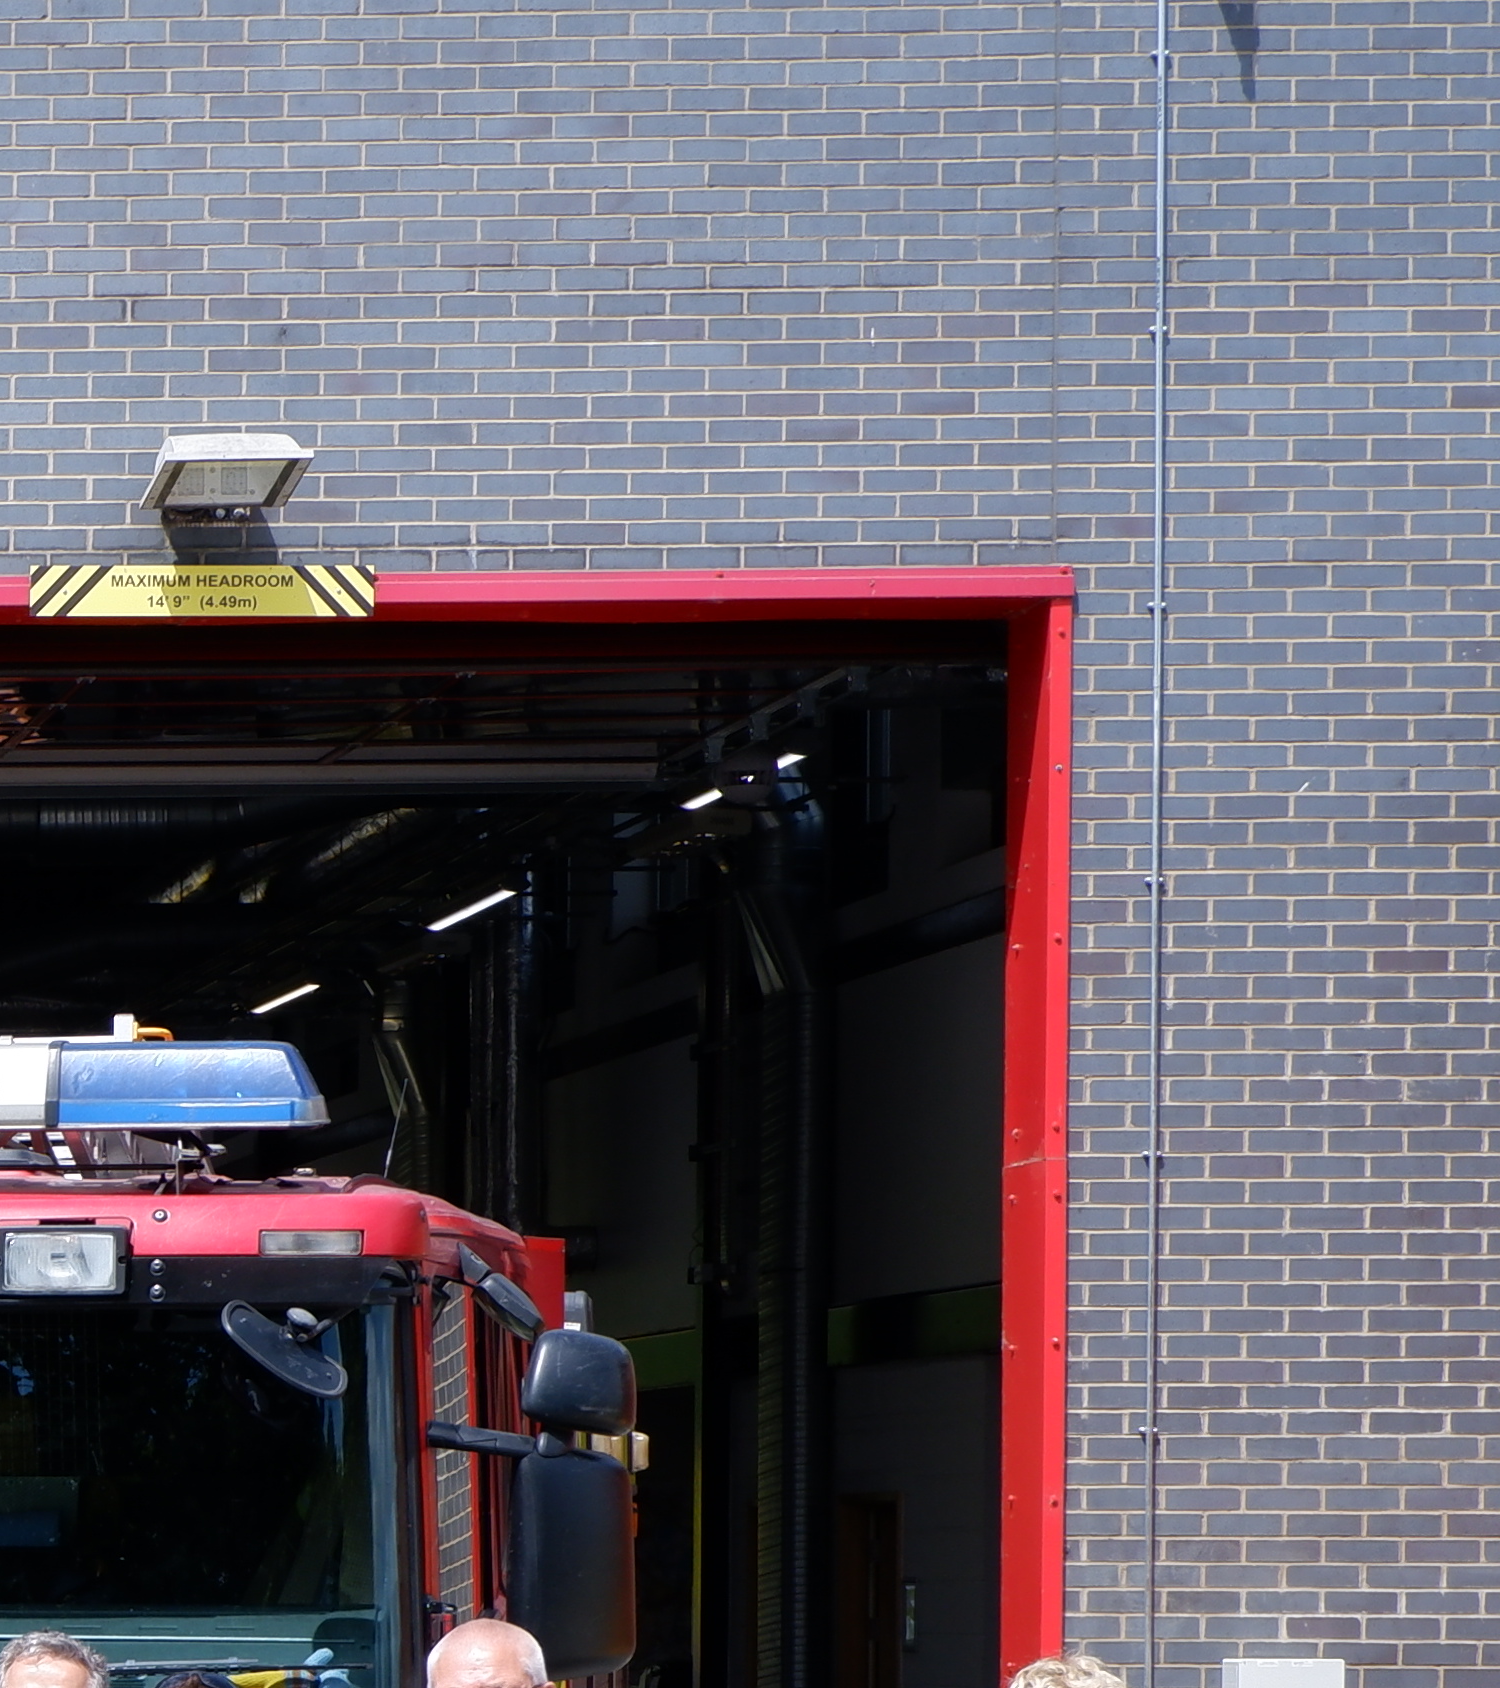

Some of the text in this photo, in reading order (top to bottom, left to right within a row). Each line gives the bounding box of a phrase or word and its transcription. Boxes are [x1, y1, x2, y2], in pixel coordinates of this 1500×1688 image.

[111, 574, 293, 588] MAXIMUM HEADROOM
[200, 595, 258, 611] (4.49m)
